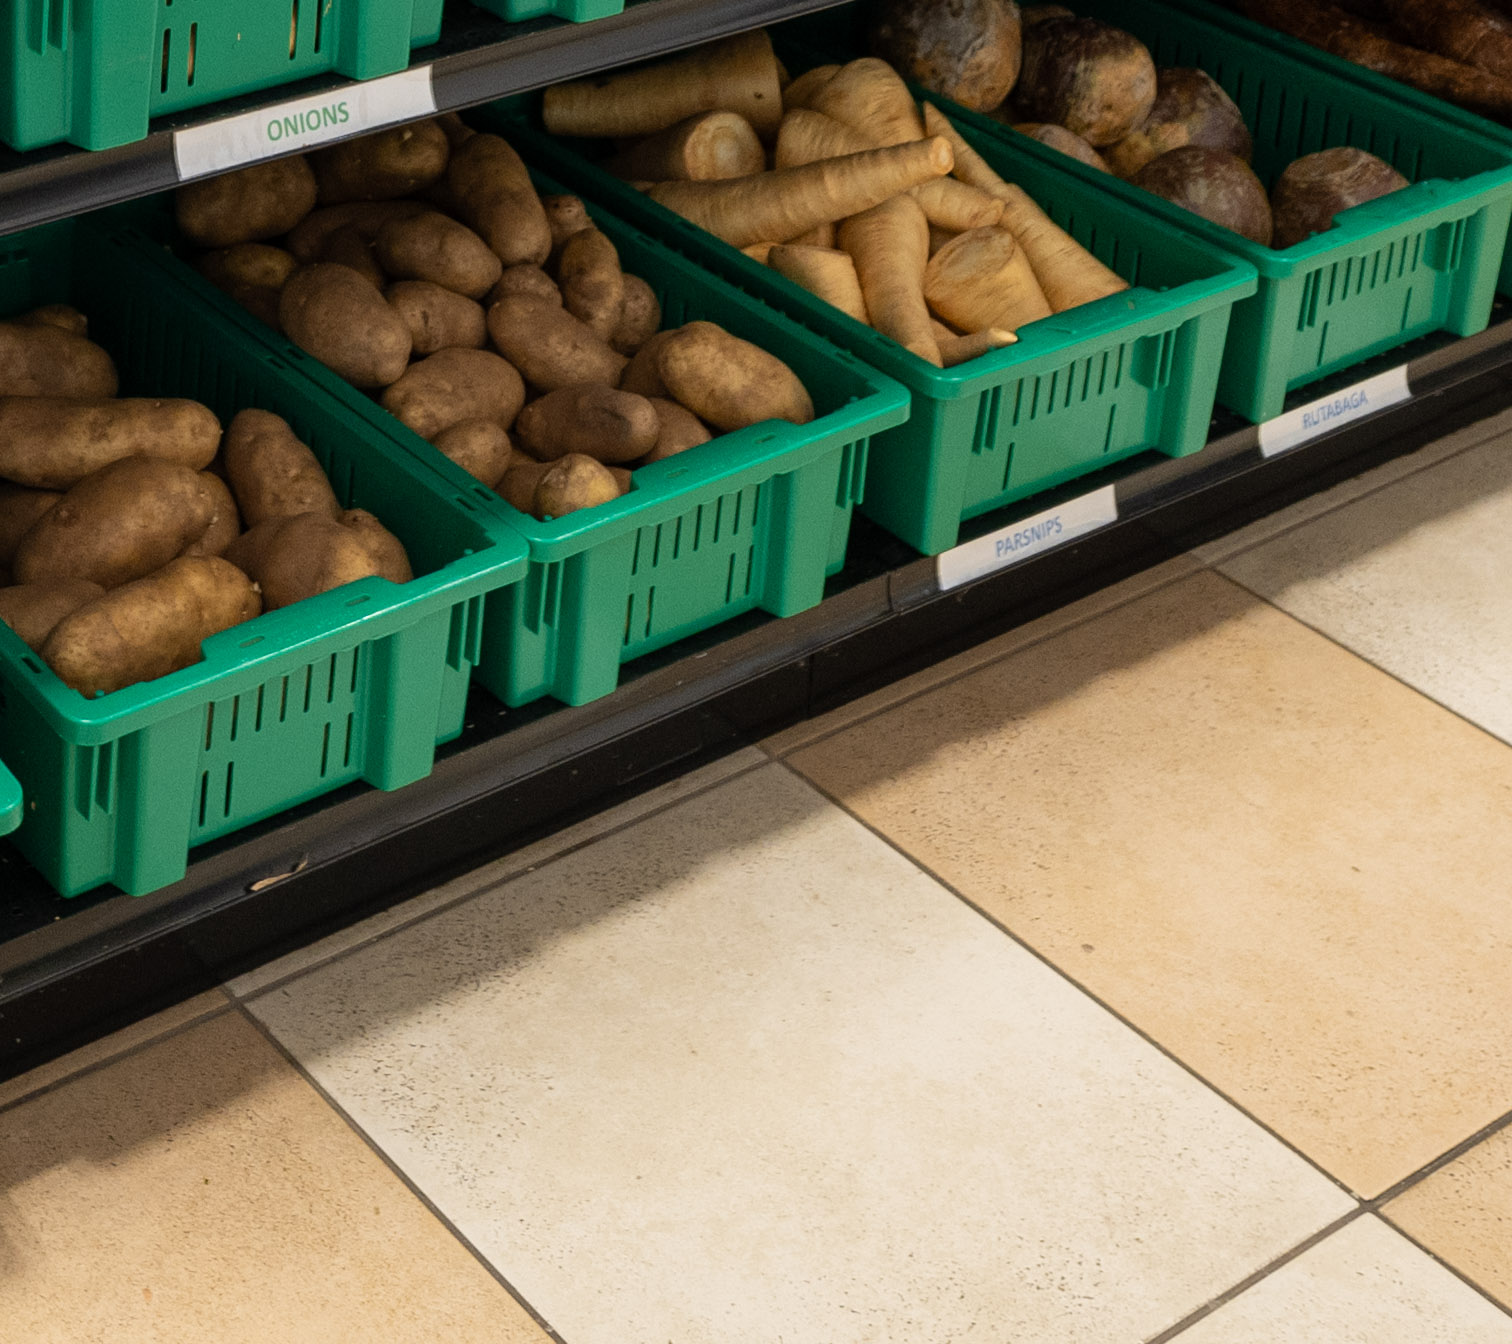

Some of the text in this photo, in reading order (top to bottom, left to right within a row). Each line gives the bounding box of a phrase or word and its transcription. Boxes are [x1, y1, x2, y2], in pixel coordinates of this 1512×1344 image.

[267, 101, 350, 142] ONIONS
[1301, 390, 1369, 431] RUTABAGA
[995, 515, 1063, 558] PARSNIPS
